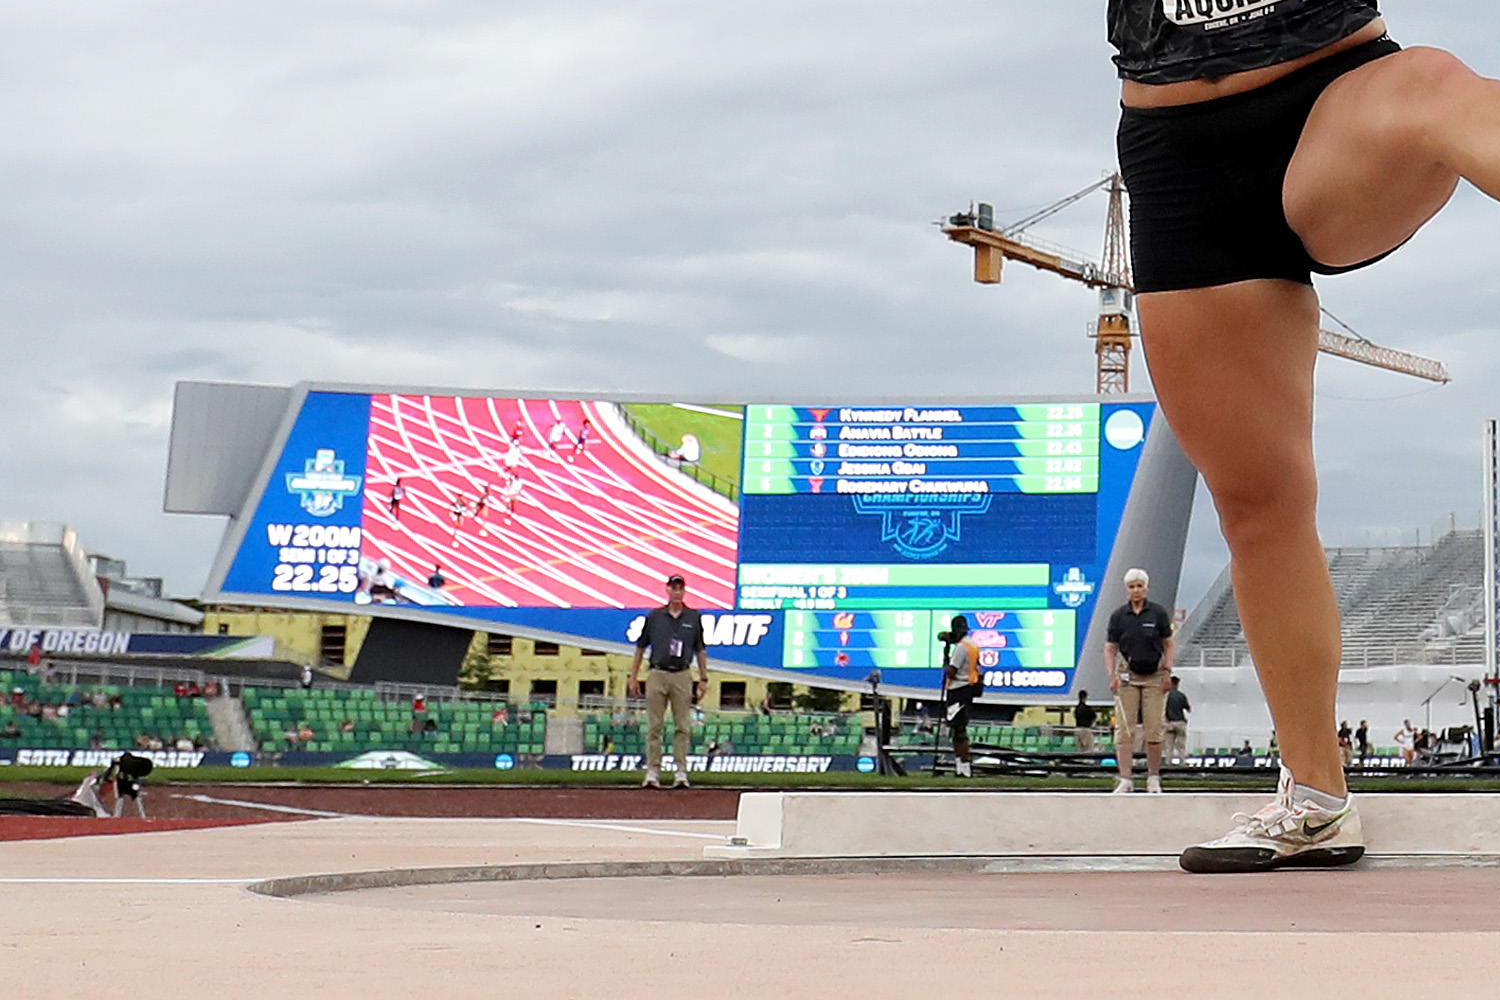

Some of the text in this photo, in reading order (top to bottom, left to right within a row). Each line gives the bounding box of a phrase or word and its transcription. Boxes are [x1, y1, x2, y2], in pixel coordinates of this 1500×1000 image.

[267, 523, 361, 548] W 200M
[327, 548, 347, 565] OF
[347, 549, 359, 565] 3
[272, 563, 358, 593] 22.25
[10, 630, 42, 650] OF
[42, 630, 132, 653] OREGON
[710, 756, 832, 773] ANNIVERSARY
